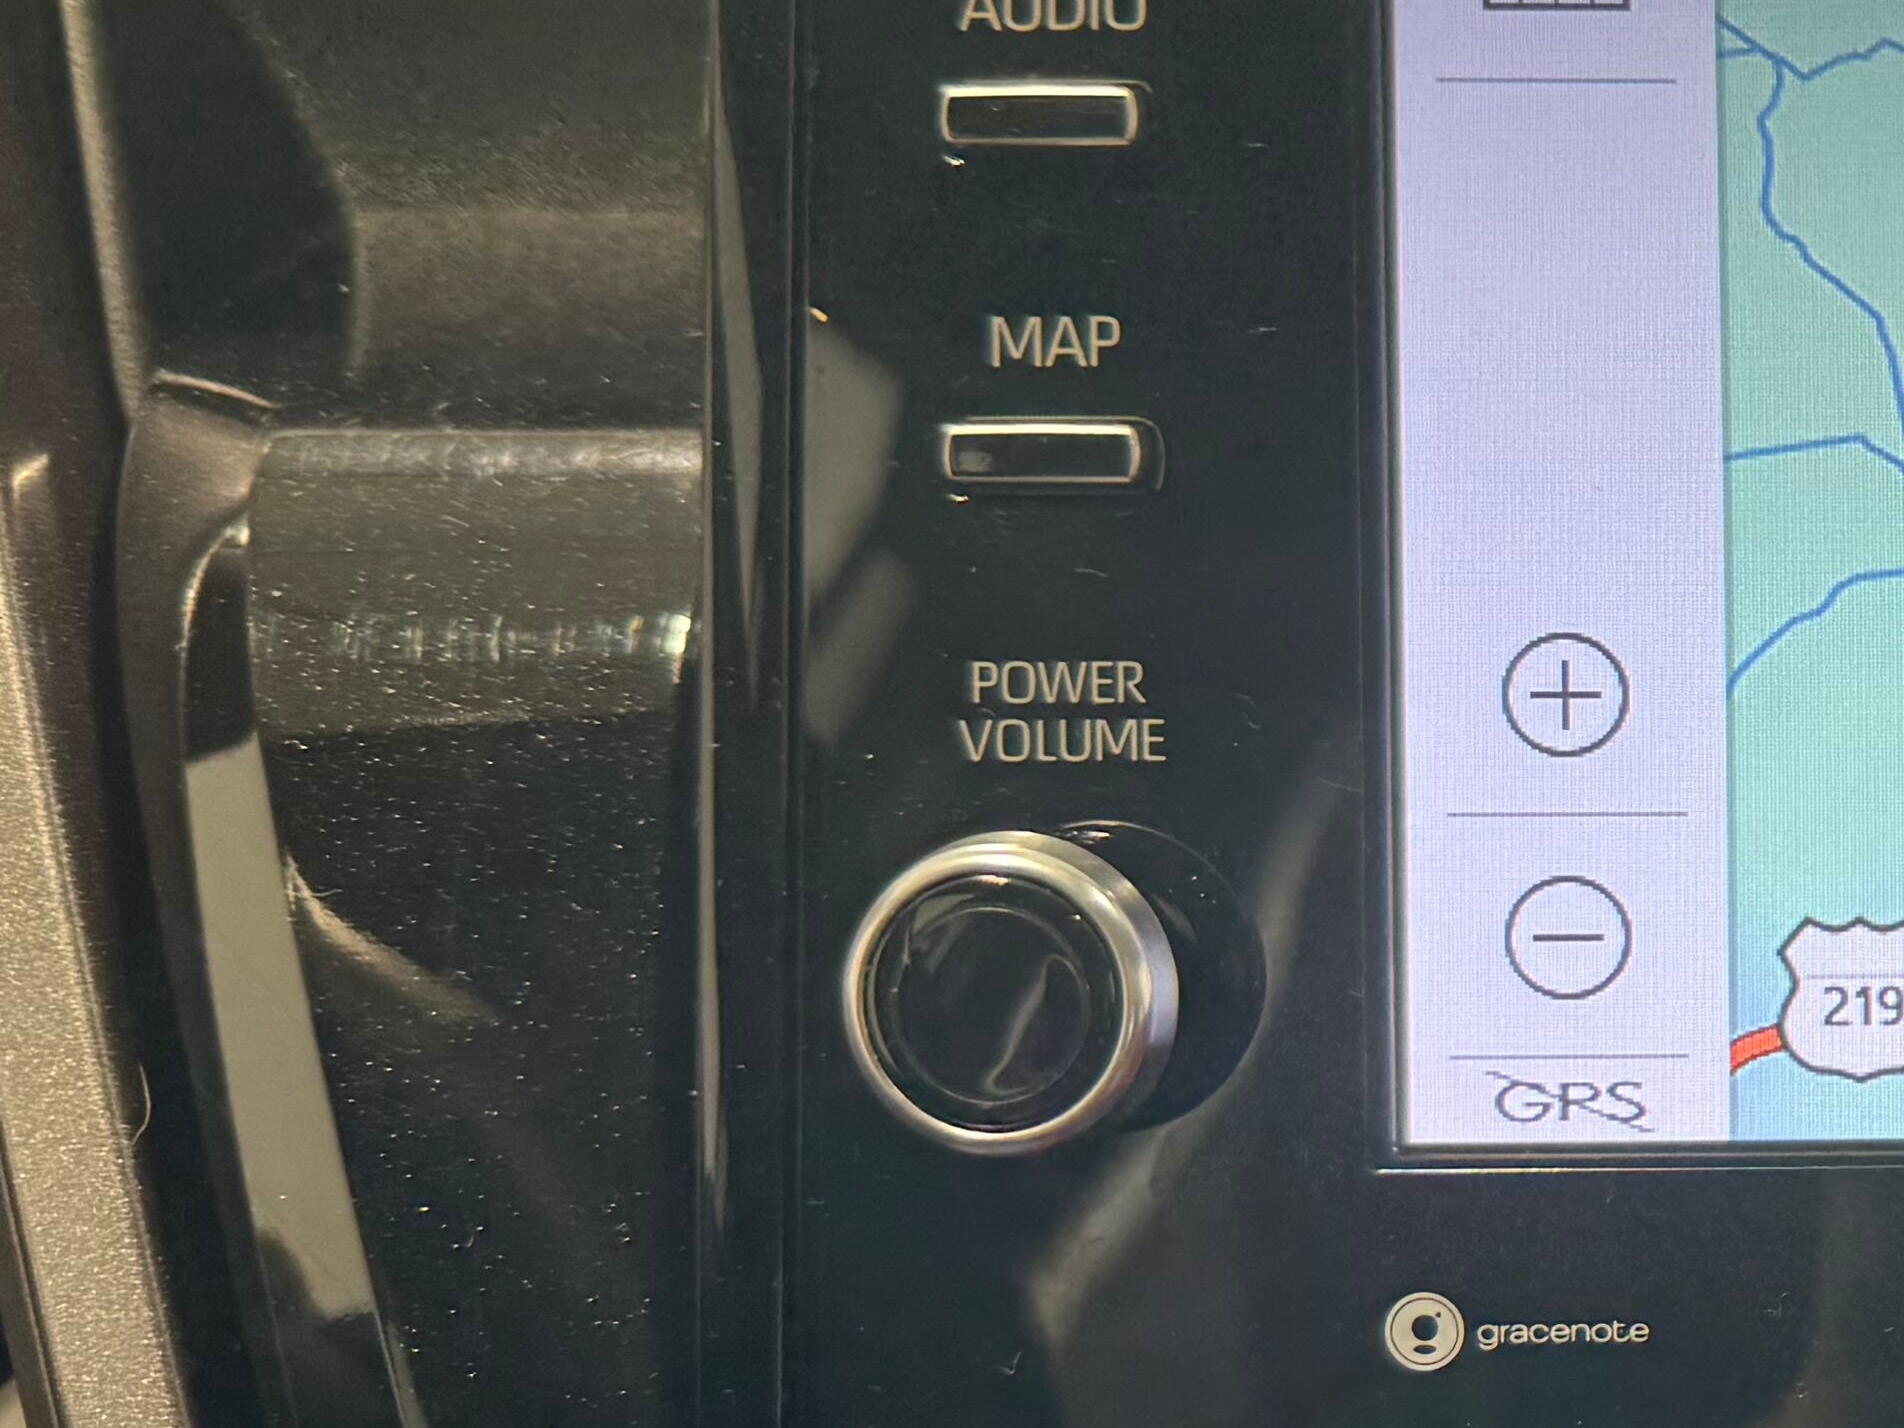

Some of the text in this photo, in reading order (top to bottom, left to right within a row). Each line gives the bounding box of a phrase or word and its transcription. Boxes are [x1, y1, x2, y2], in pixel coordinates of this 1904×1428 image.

[990, 315, 1122, 368] MAP
[972, 660, 1147, 705] POWER
[959, 718, 1167, 763] VOLUME
[1823, 985, 1904, 1027] 219
[1476, 1320, 1650, 1351] gracenote
